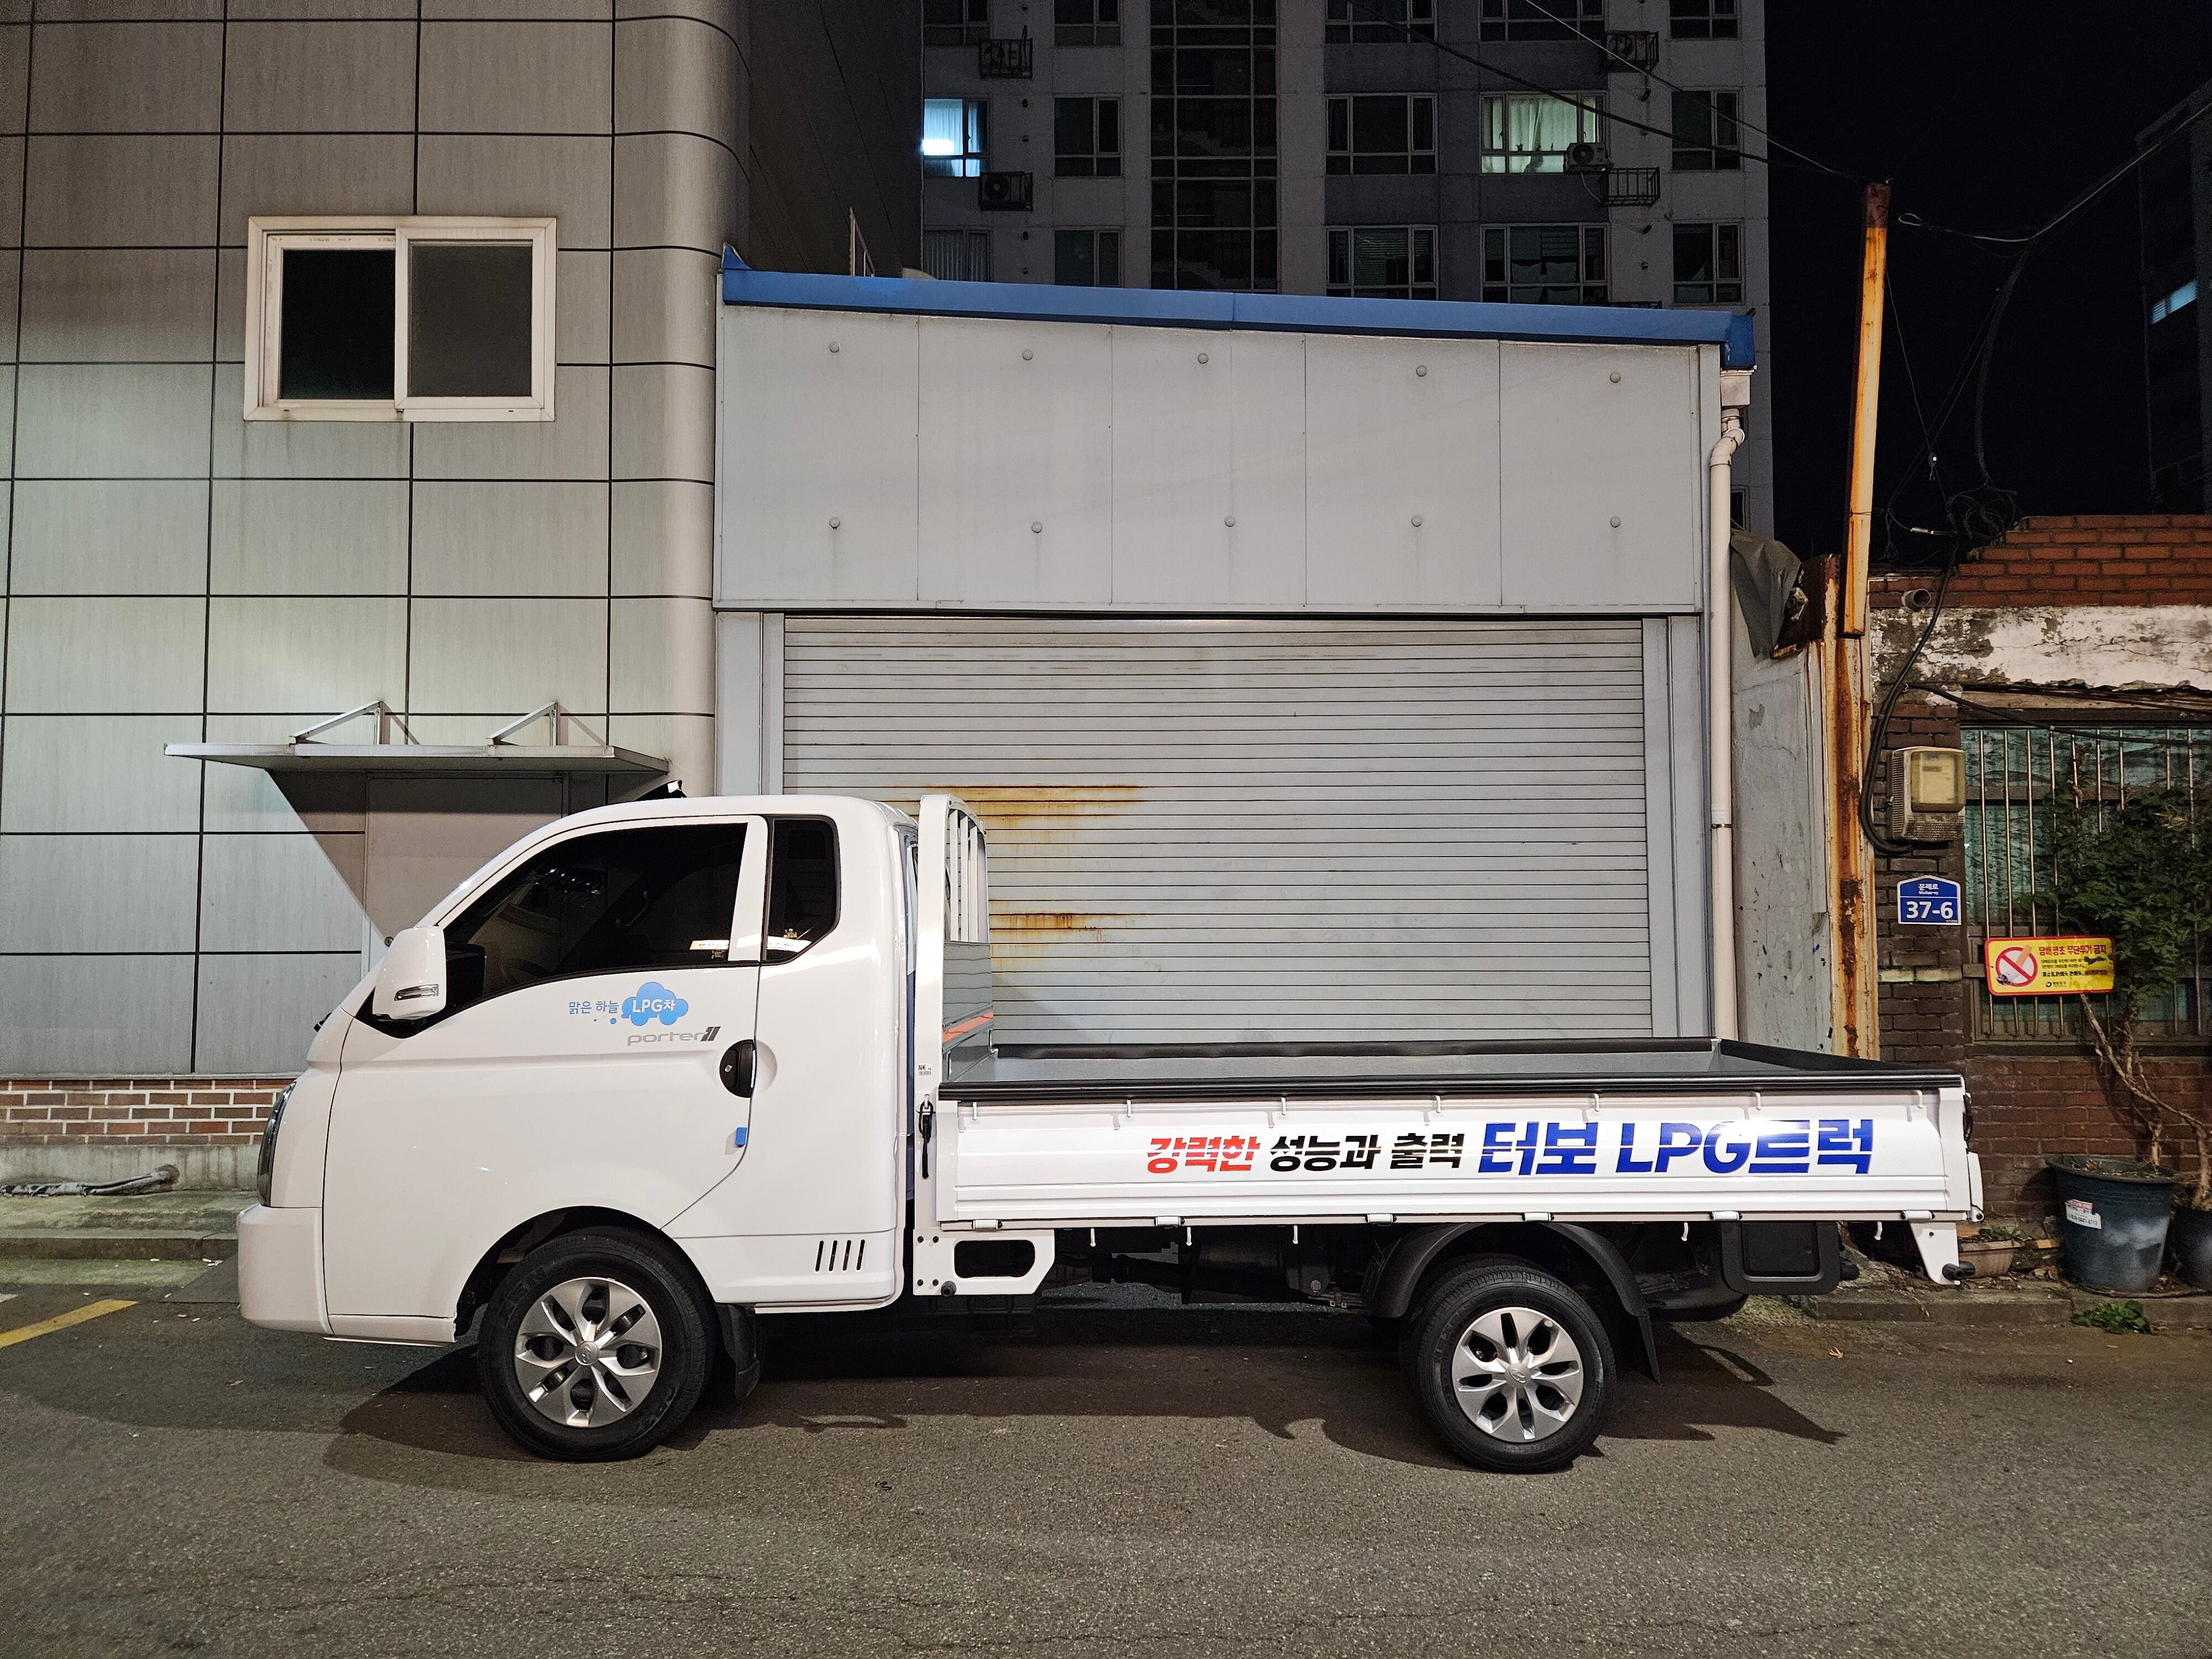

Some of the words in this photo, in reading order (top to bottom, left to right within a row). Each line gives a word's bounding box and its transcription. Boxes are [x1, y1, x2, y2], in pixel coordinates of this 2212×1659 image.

[1906, 901, 1954, 919] 37-6
[2067, 945, 2092, 955] 무단투기
[2094, 945, 2107, 954] 금지
[568, 1001, 592, 1014] 맑은
[595, 1000, 619, 1014] 하늘
[632, 998, 676, 1014] LPG차
[1147, 1135, 1261, 1174] 강력한
[1269, 1135, 1381, 1172] 성능과
[1390, 1133, 1465, 1170] 출력
[1478, 1122, 1598, 1176] 터보
[1615, 1119, 1874, 1175] LPG트럭
